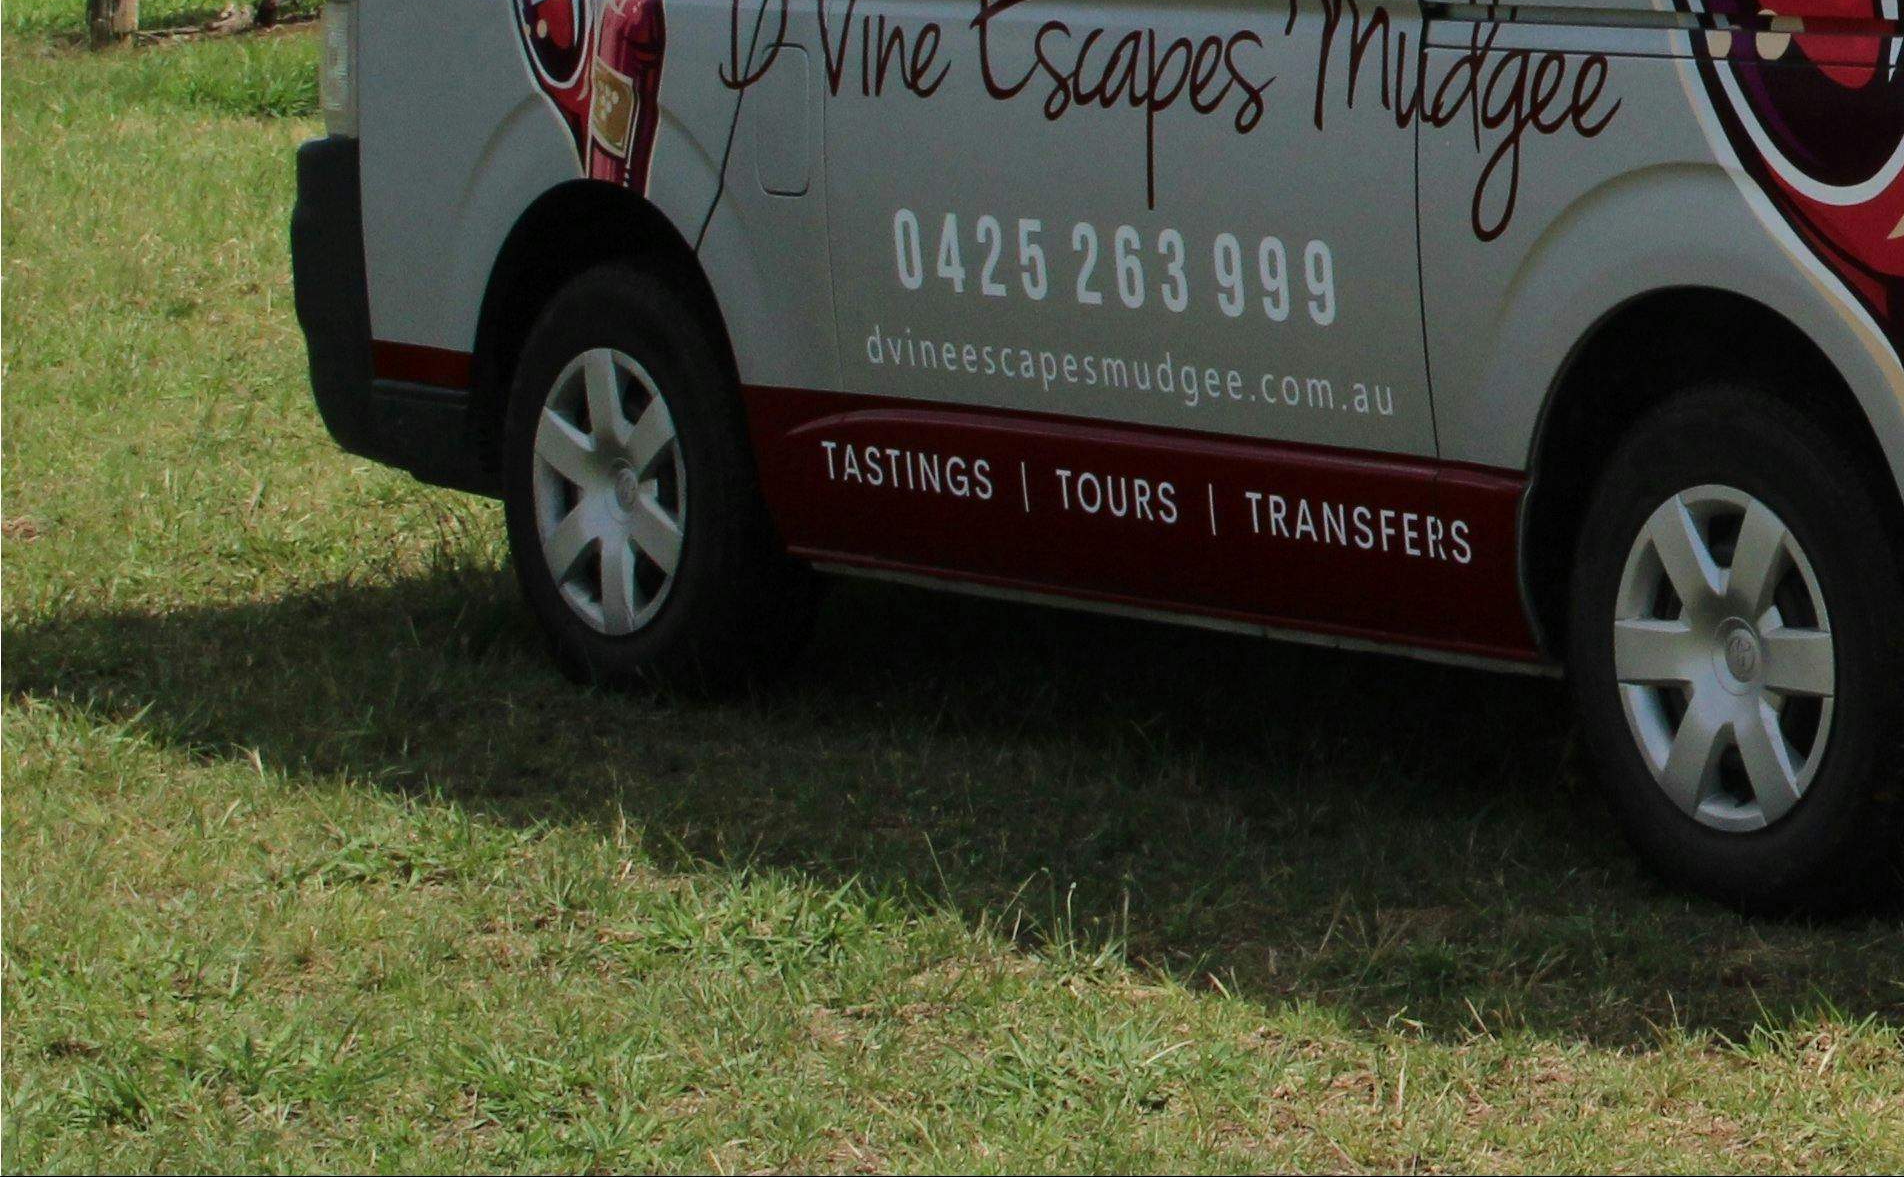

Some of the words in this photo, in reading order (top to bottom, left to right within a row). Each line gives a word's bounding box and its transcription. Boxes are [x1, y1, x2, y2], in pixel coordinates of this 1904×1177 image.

[893, 207, 1048, 301] 0425
[1072, 221, 1189, 314] 263
[1213, 231, 1337, 327] 999
[865, 325, 1396, 418] dvineescapesmudgee.com.au
[821, 439, 994, 501] TASTINGS
[1056, 467, 1179, 524] TOURS
[1245, 491, 1473, 566] TRANSFERS
